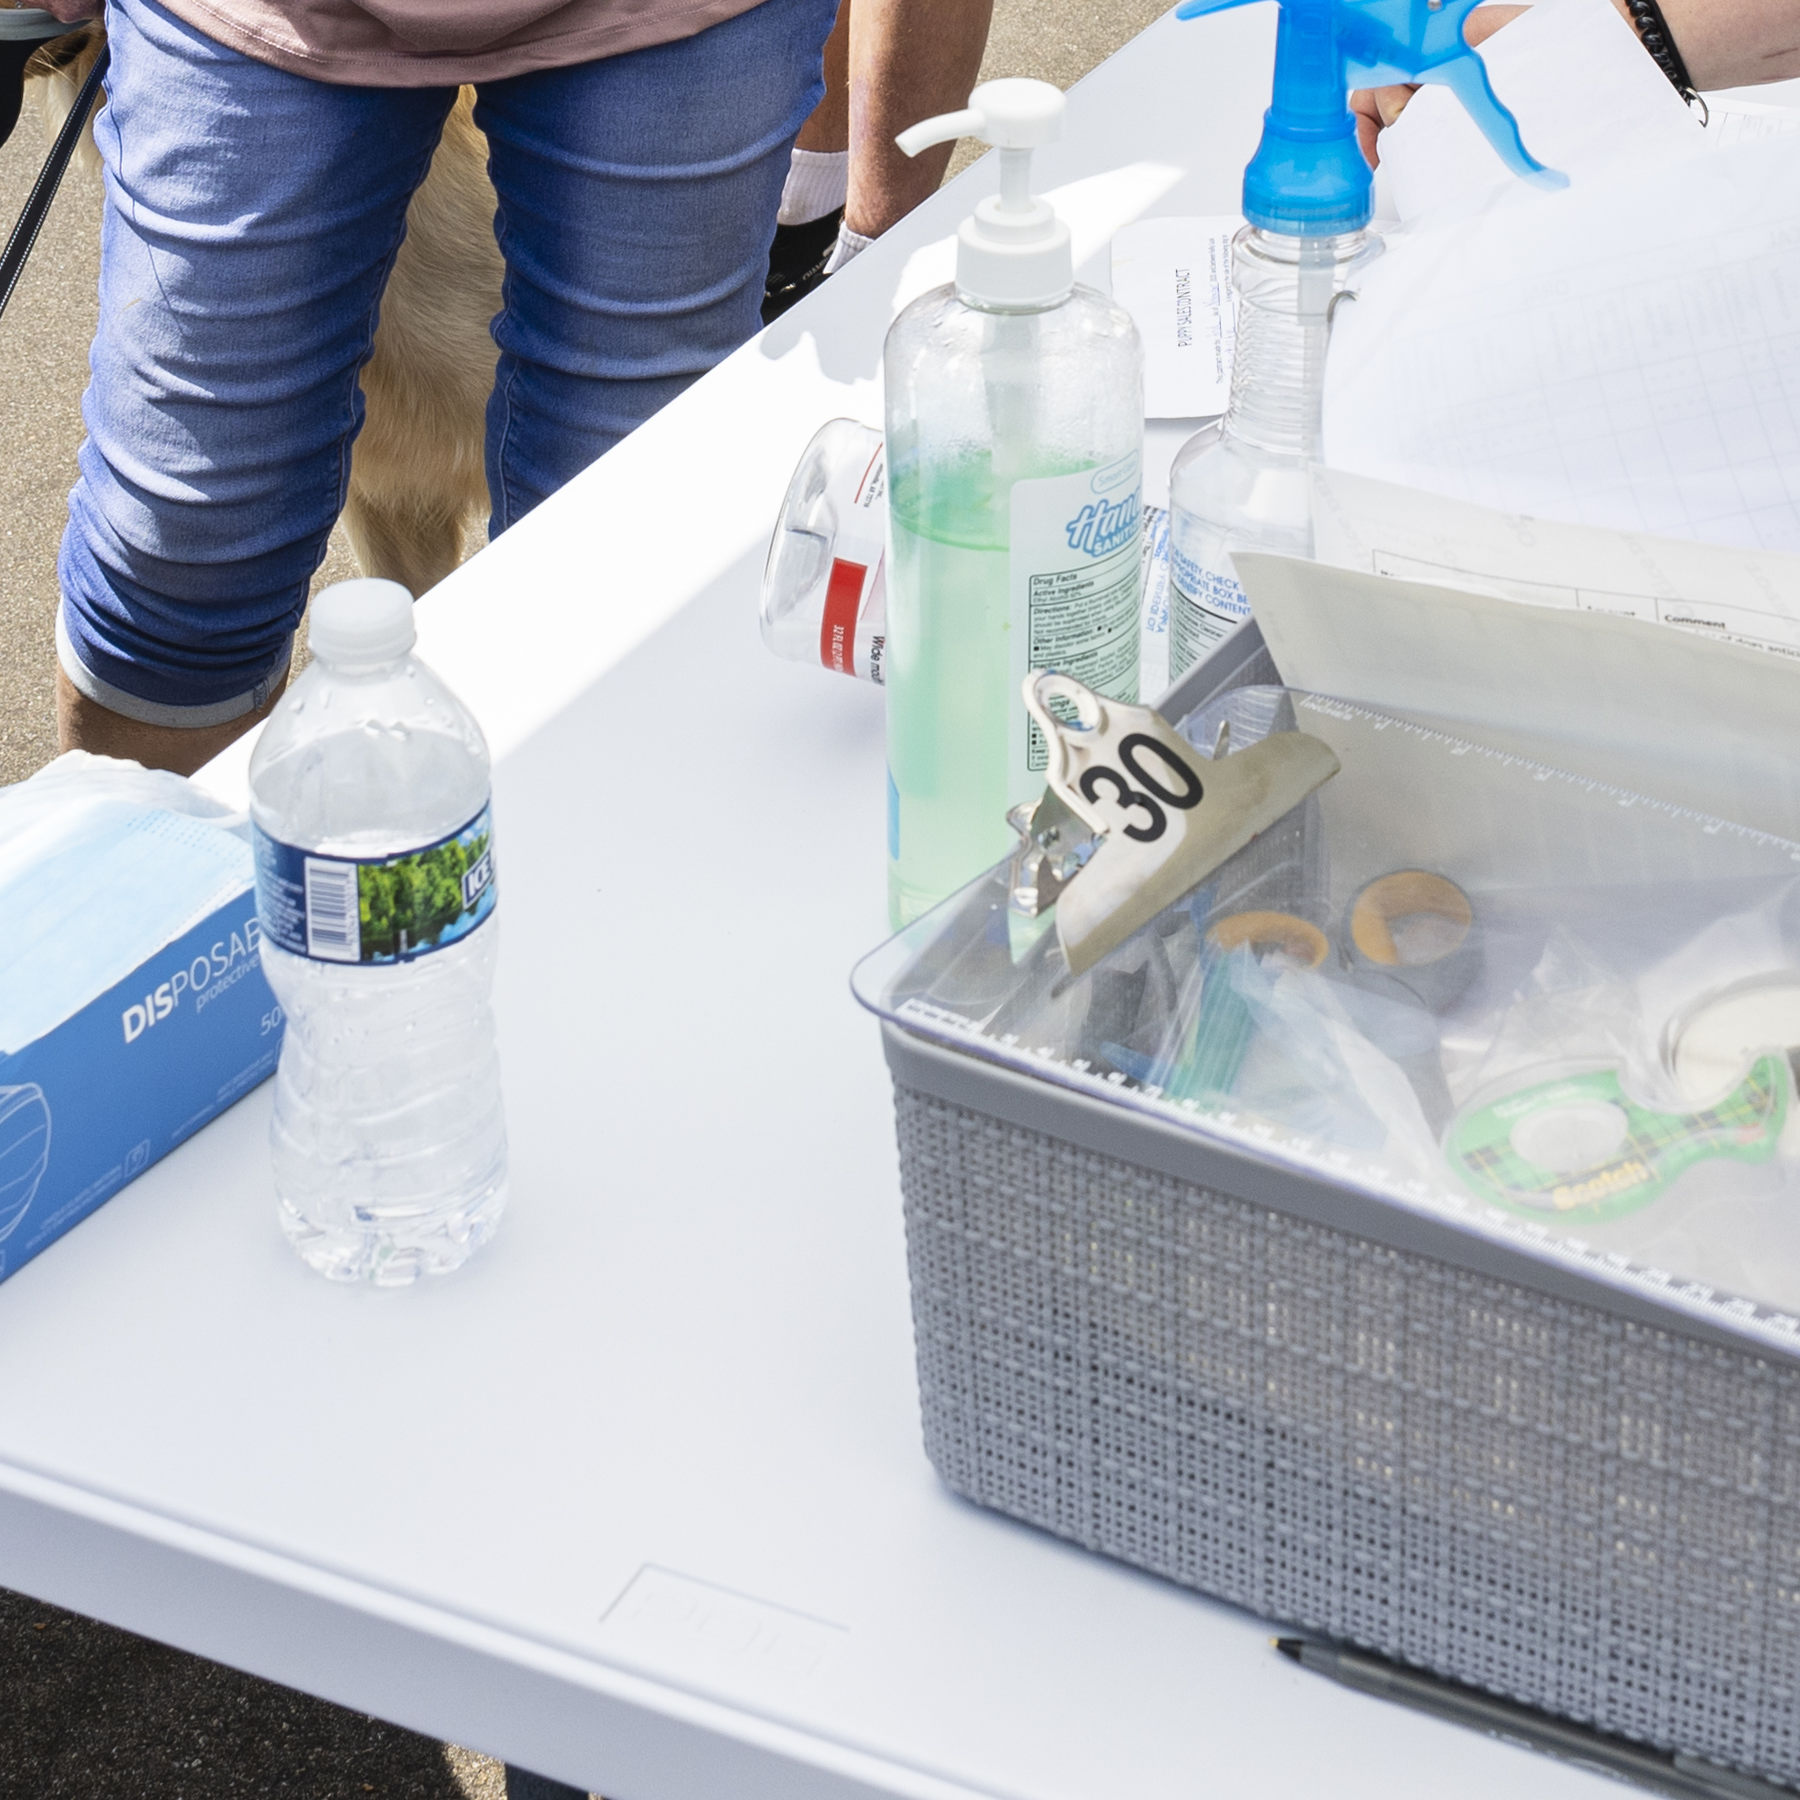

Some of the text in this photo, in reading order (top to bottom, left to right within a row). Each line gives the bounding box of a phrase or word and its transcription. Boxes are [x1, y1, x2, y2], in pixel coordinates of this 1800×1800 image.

[1175, 268, 1192, 306] CONTRACT
[1033, 574, 1077, 586] Drug Facts
[1206, 570, 1240, 591] CHECK
[1213, 584, 1235, 601] BOX
[1664, 613, 1728, 630] Comment
[871, 635, 885, 661] Wide
[1079, 733, 1204, 843] 30
[468, 856, 492, 898] ICE
[122, 917, 261, 1044] DISPOSAB
[1552, 1161, 1648, 1211] Scotch
